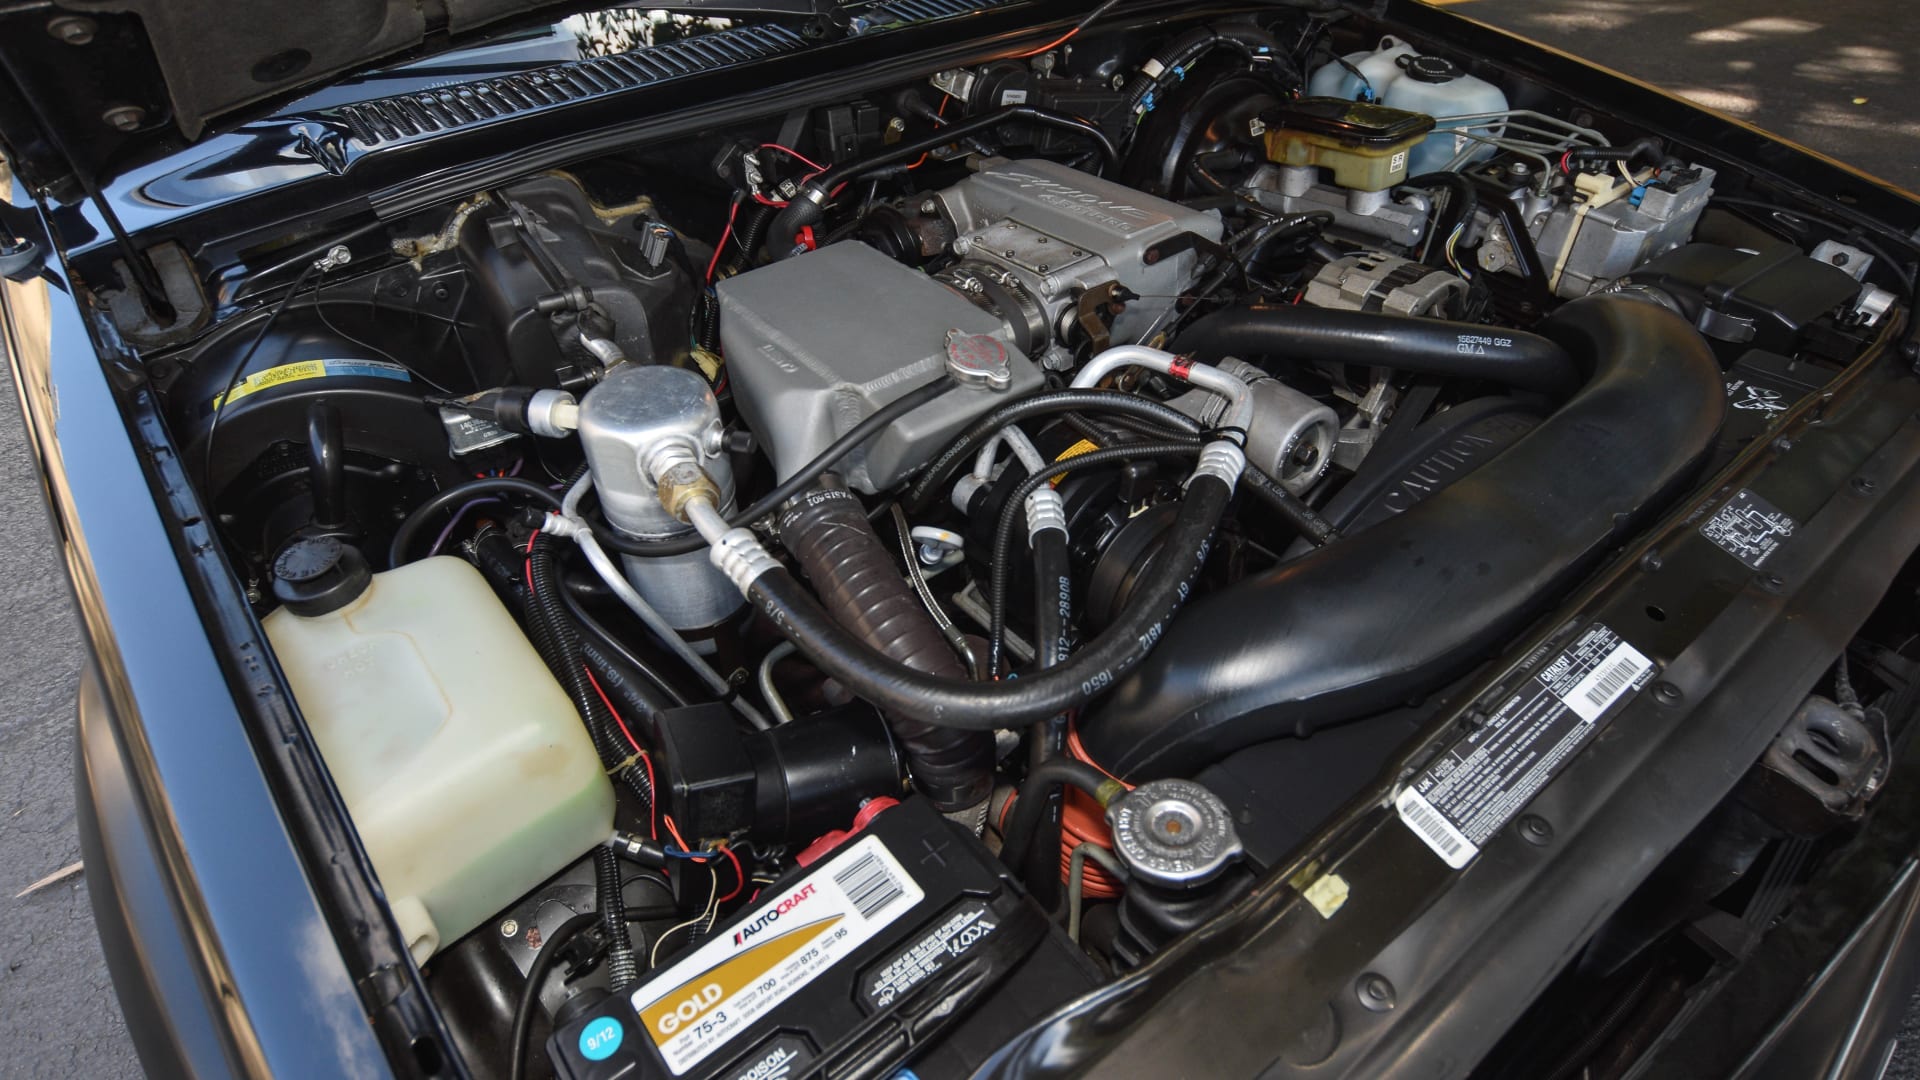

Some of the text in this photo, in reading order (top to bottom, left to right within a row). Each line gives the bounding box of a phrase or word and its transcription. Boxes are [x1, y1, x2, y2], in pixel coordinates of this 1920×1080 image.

[1456, 343, 1474, 353] GM
[1383, 433, 1494, 514] CAUTION
[1177, 581, 1190, 602] GY
[1138, 621, 1163, 651] 4812
[1539, 654, 1570, 683] CATALYST
[1082, 668, 1114, 696] 1650
[740, 883, 817, 940] AUTOCRAFT
[833, 926, 848, 940] 95
[798, 947, 819, 965] 875
[756, 977, 777, 995] 700
[657, 983, 723, 1035] GOLD
[693, 1010, 727, 1036] 75-3
[586, 1026, 615, 1051] 9/12
